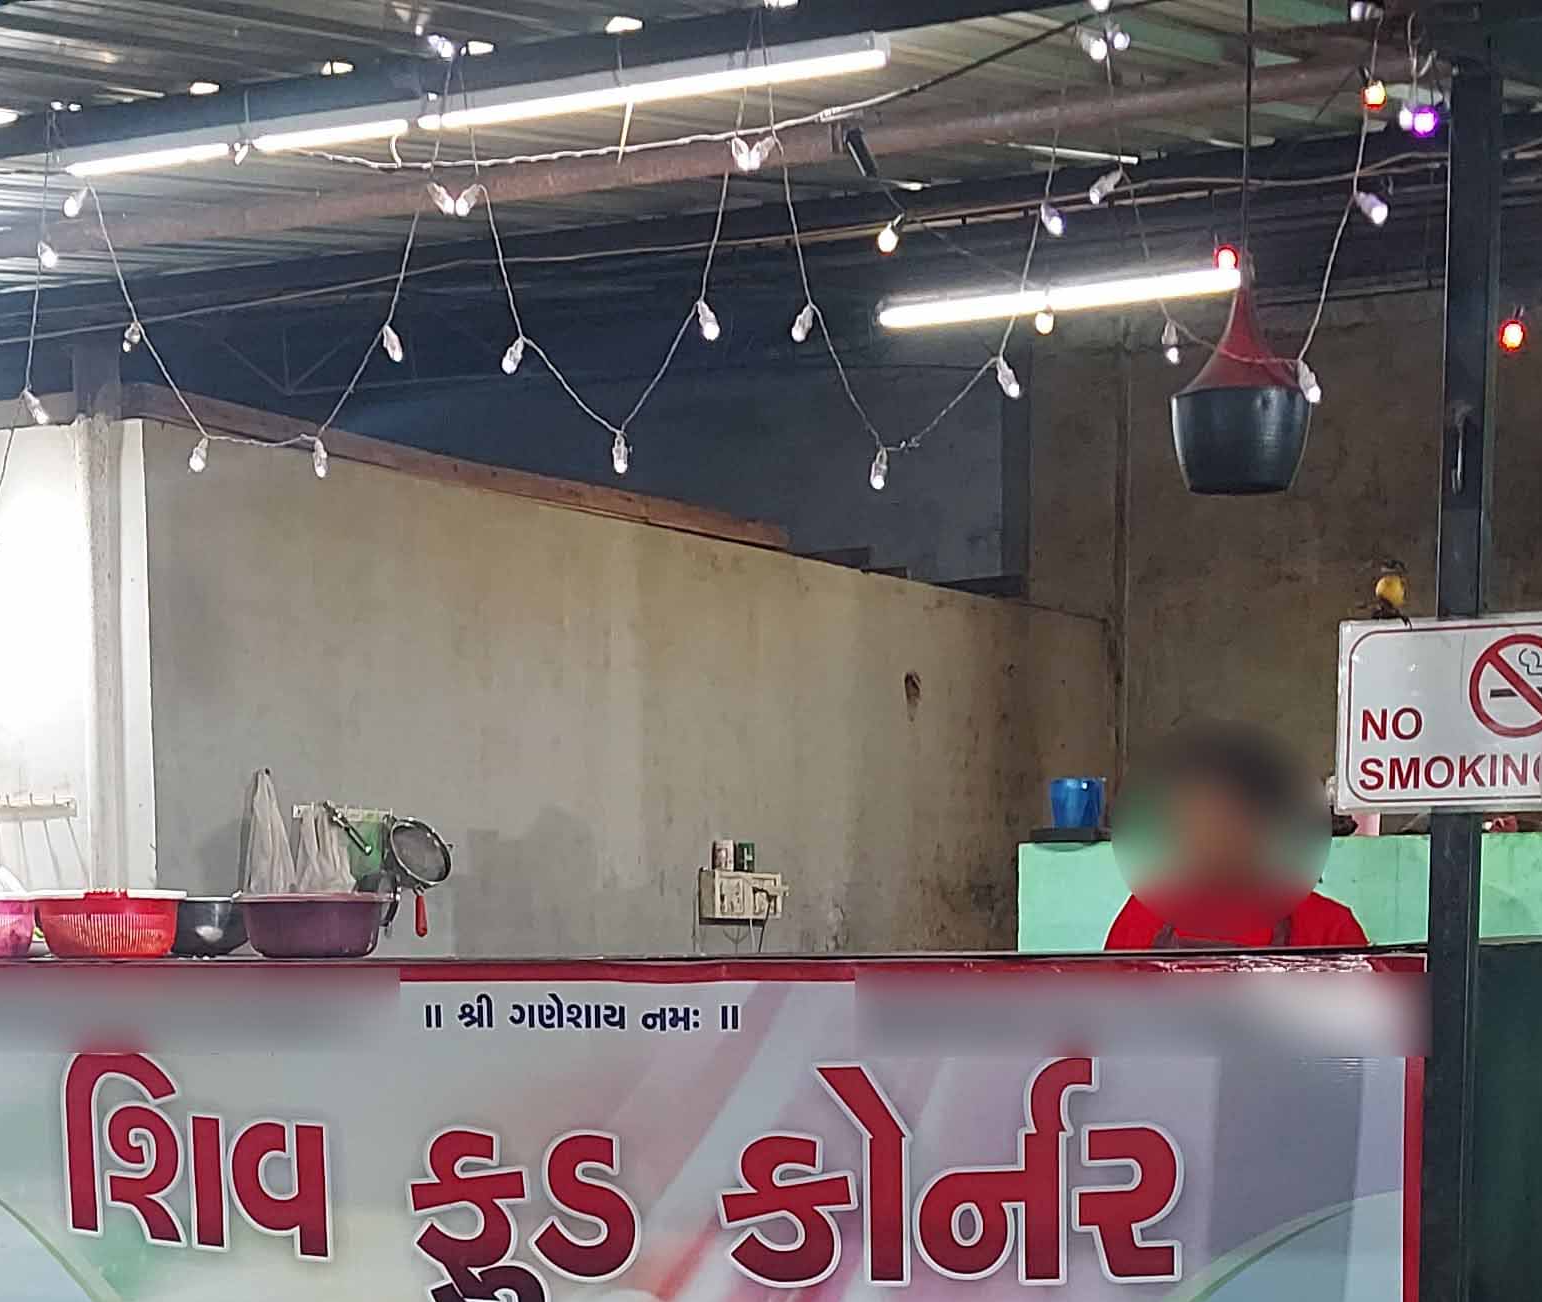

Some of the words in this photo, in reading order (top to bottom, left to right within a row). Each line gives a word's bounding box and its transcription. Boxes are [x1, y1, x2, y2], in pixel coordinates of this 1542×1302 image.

[1361, 706, 1424, 743] NO
[1359, 751, 1541, 791] SMOKIN
[458, 993, 494, 1029] શ્રી
[509, 992, 627, 1030] ગણેશાય
[62, 1052, 331, 1260] શિવ
[718, 1056, 1183, 1287] કોર્નર
